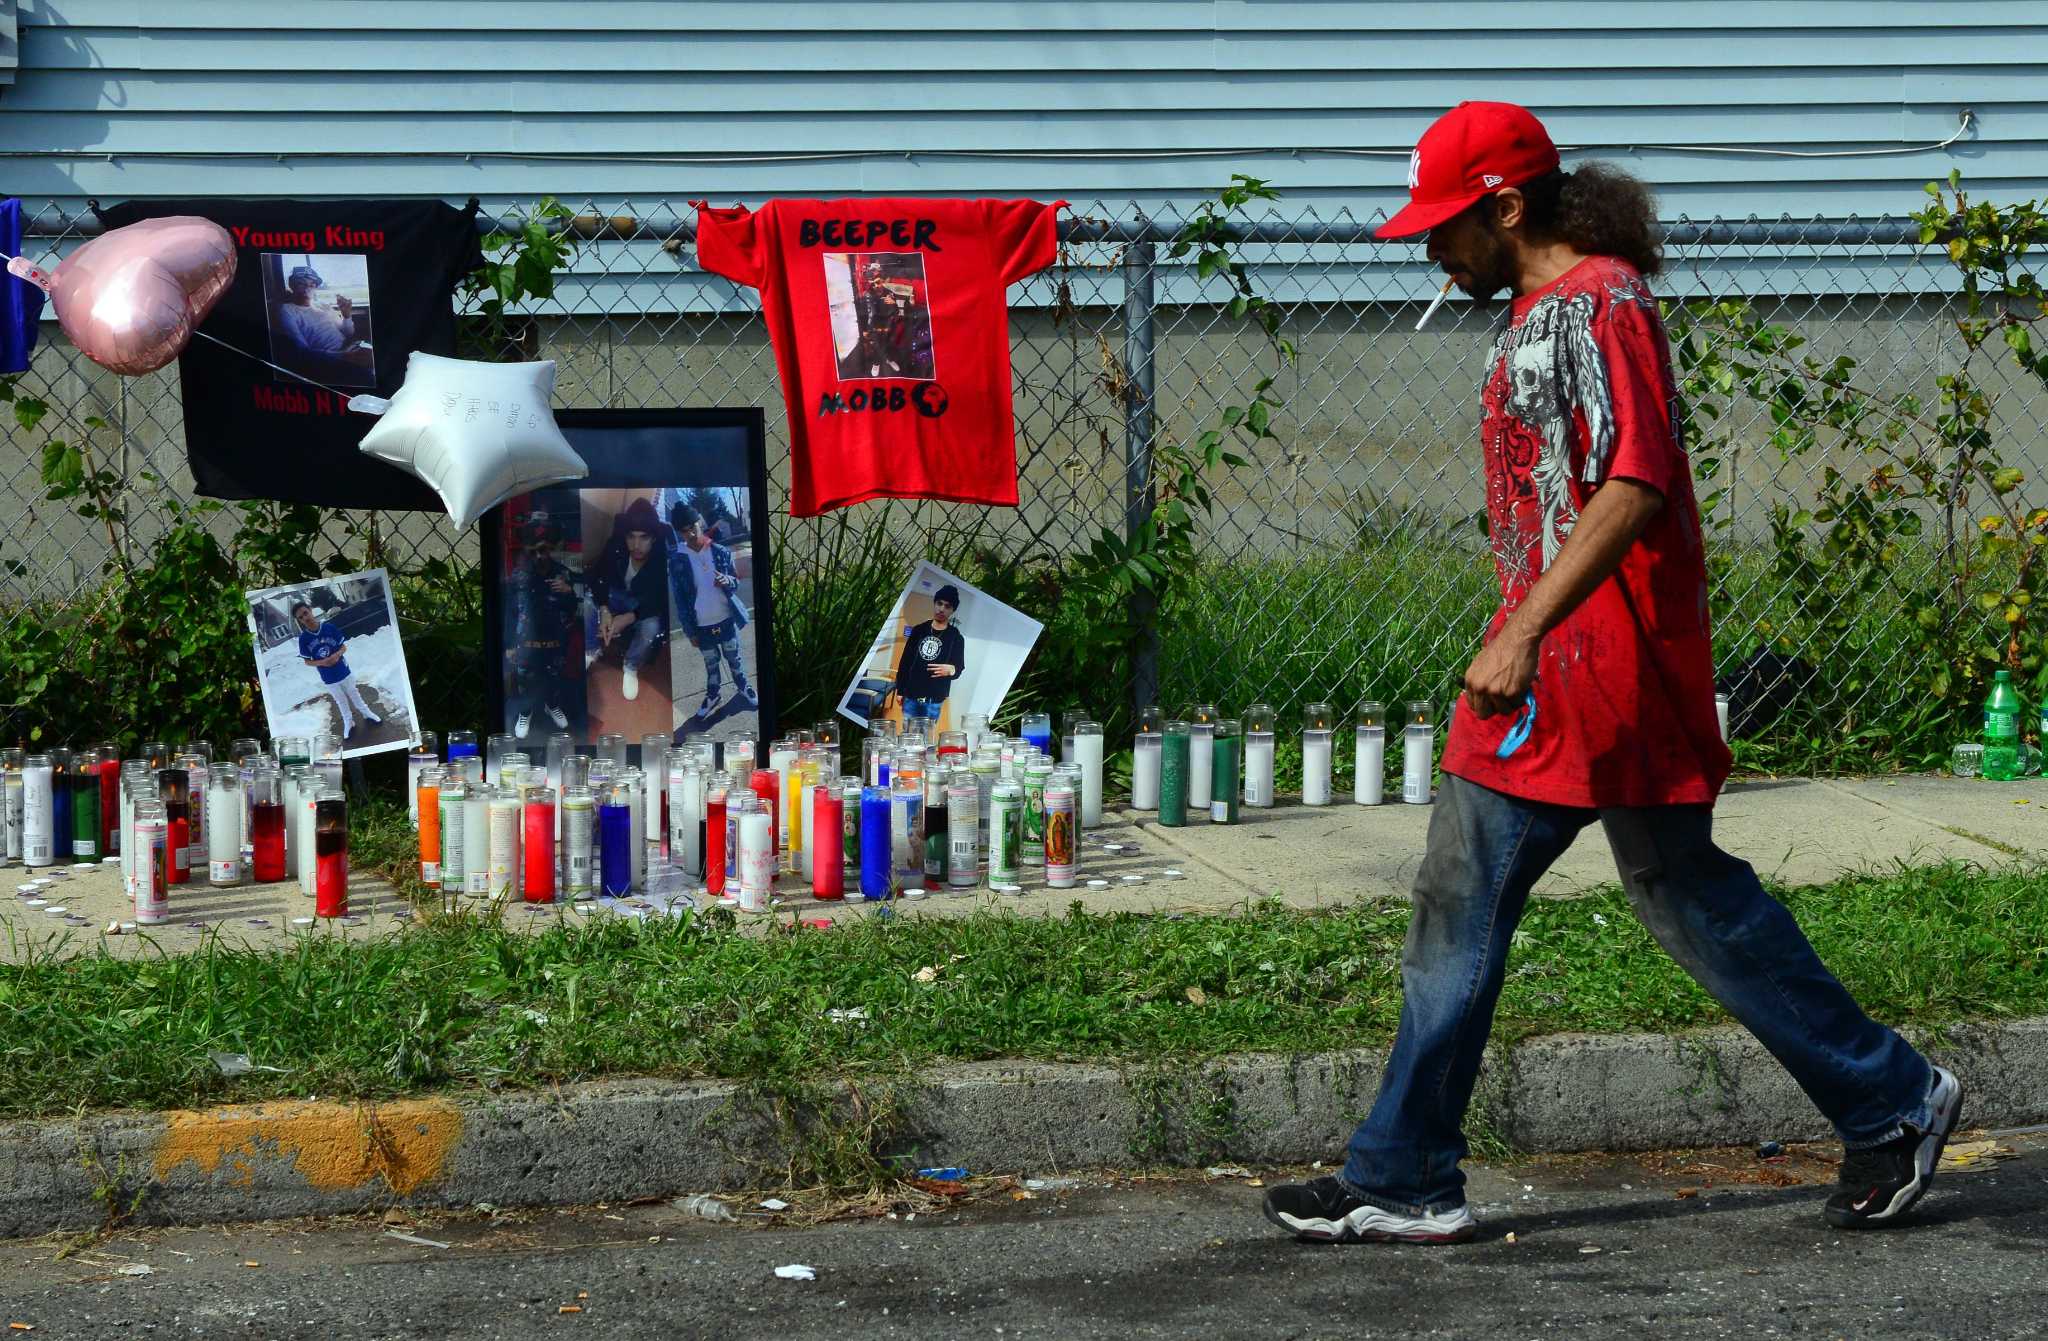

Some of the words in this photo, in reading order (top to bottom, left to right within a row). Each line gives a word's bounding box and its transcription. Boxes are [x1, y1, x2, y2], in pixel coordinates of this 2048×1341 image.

[231, 225, 315, 251] Young
[325, 224, 385, 250] King
[800, 219, 941, 251] BEEPER
[254, 384, 310, 414] Mobb
[819, 386, 906, 417] MOBB
